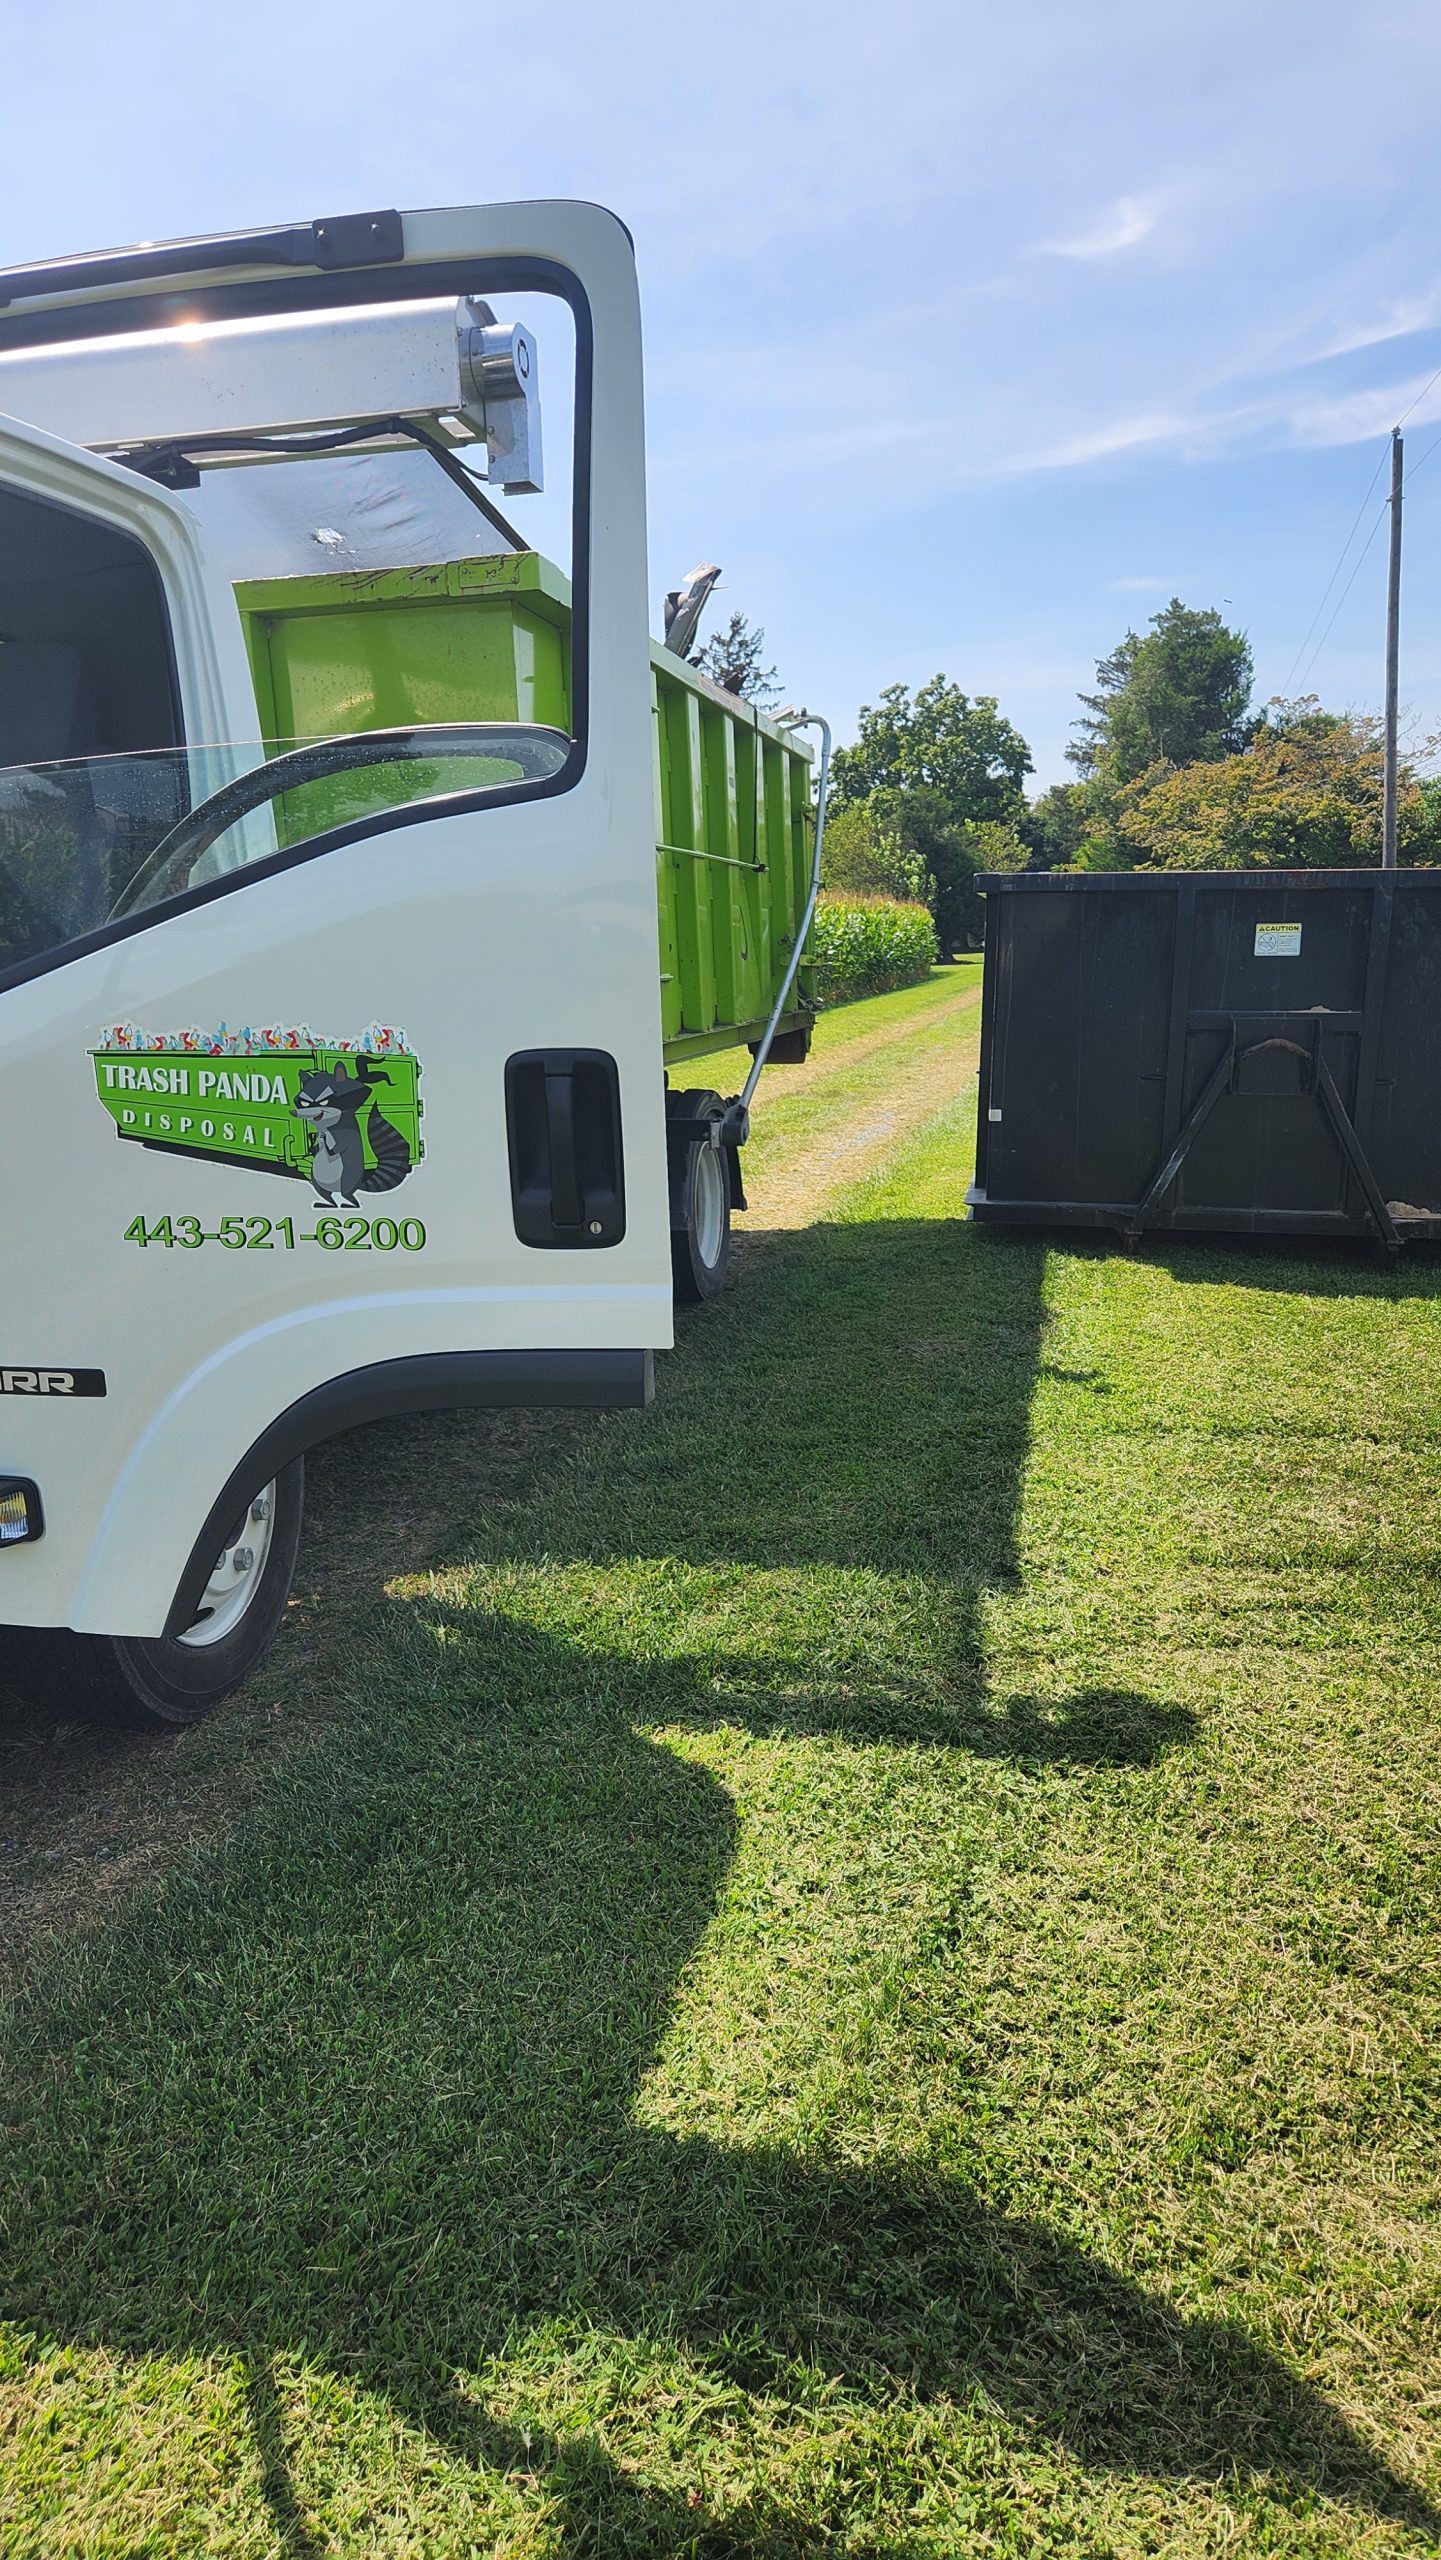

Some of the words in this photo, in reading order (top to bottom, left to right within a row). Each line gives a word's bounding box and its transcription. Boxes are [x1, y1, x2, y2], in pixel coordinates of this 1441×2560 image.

[101, 1064, 189, 1096] TRASH
[199, 1069, 290, 1106] PANDA
[122, 1109, 277, 1148] DISPOSAL
[124, 1215, 427, 1251] 443-521-6200
[0, 1370, 75, 1393] RR
